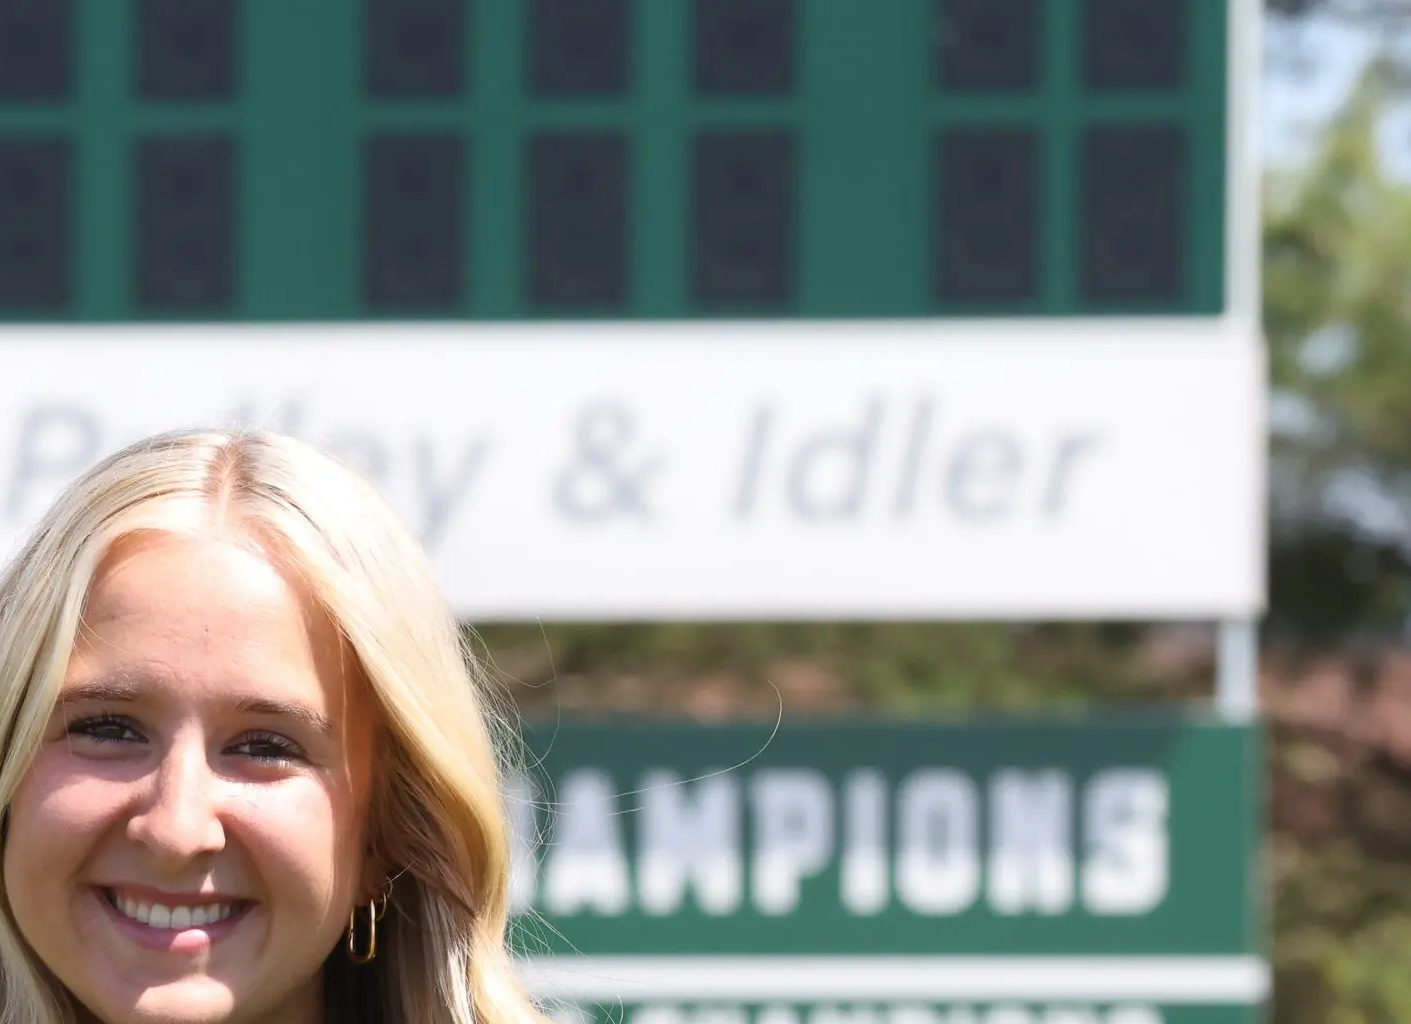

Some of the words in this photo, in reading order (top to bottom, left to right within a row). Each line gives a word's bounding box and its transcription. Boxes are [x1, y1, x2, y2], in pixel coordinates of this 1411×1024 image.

[550, 400, 661, 530] &
[730, 394, 1101, 528] Idler
[503, 768, 1172, 917] AMPIONS
